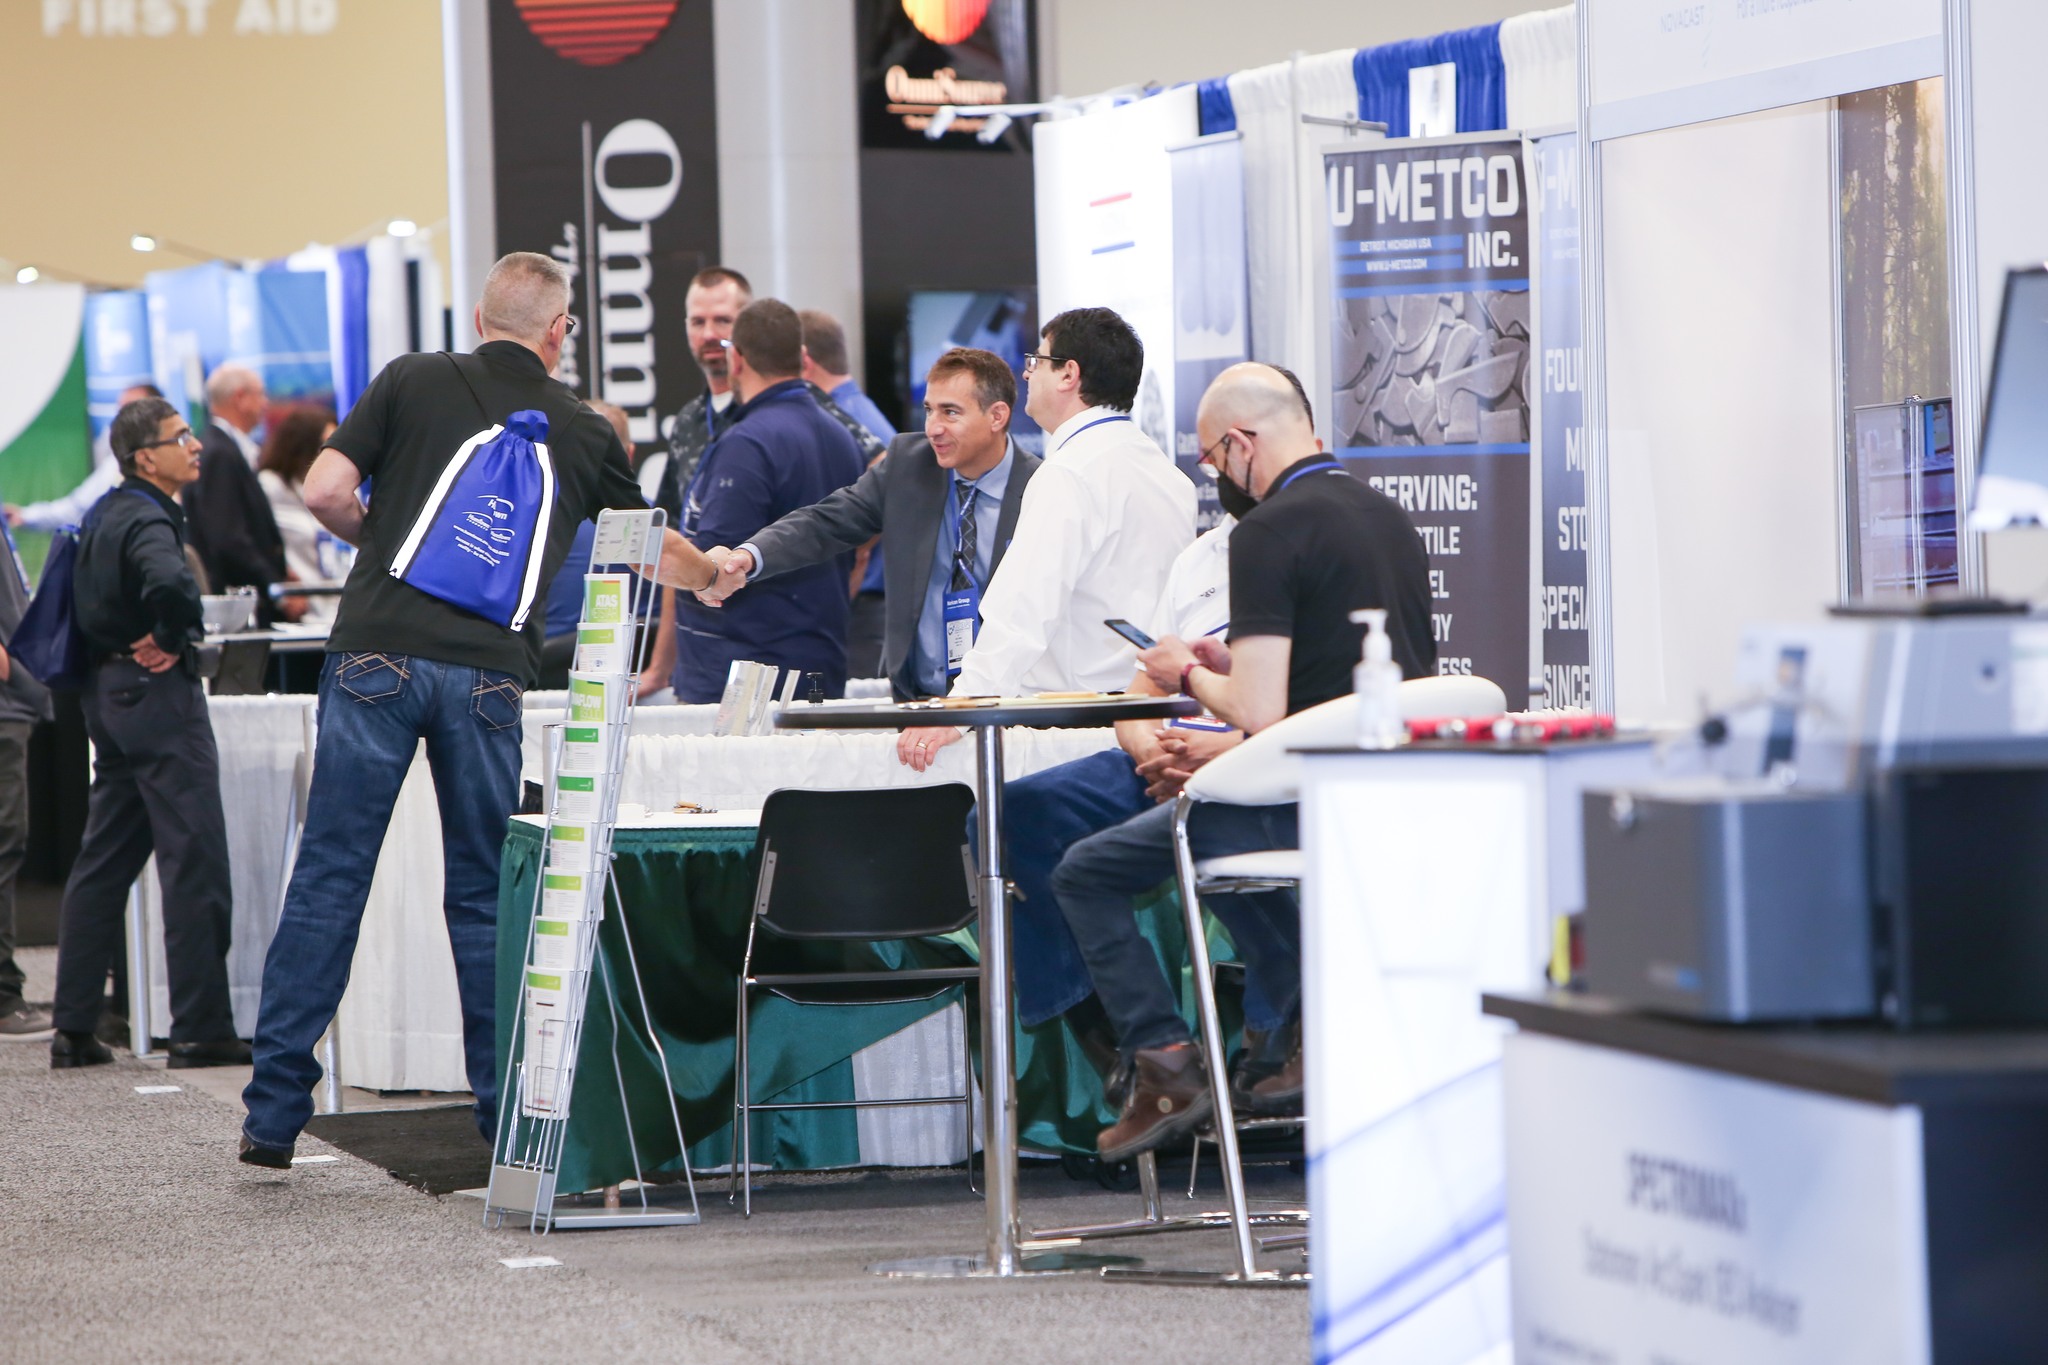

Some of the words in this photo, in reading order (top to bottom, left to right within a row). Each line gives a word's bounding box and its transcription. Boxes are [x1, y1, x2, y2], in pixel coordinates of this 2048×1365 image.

[41, 0, 212, 38] FIRST
[233, 0, 338, 37] AID
[1330, 154, 1520, 227] U-METCO
[1467, 230, 1519, 269] INC.
[1414, 526, 1461, 555] TILE
[1428, 570, 1450, 599] EL
[1541, 585, 1589, 630] SPECI
[1438, 657, 1473, 678] ESS
